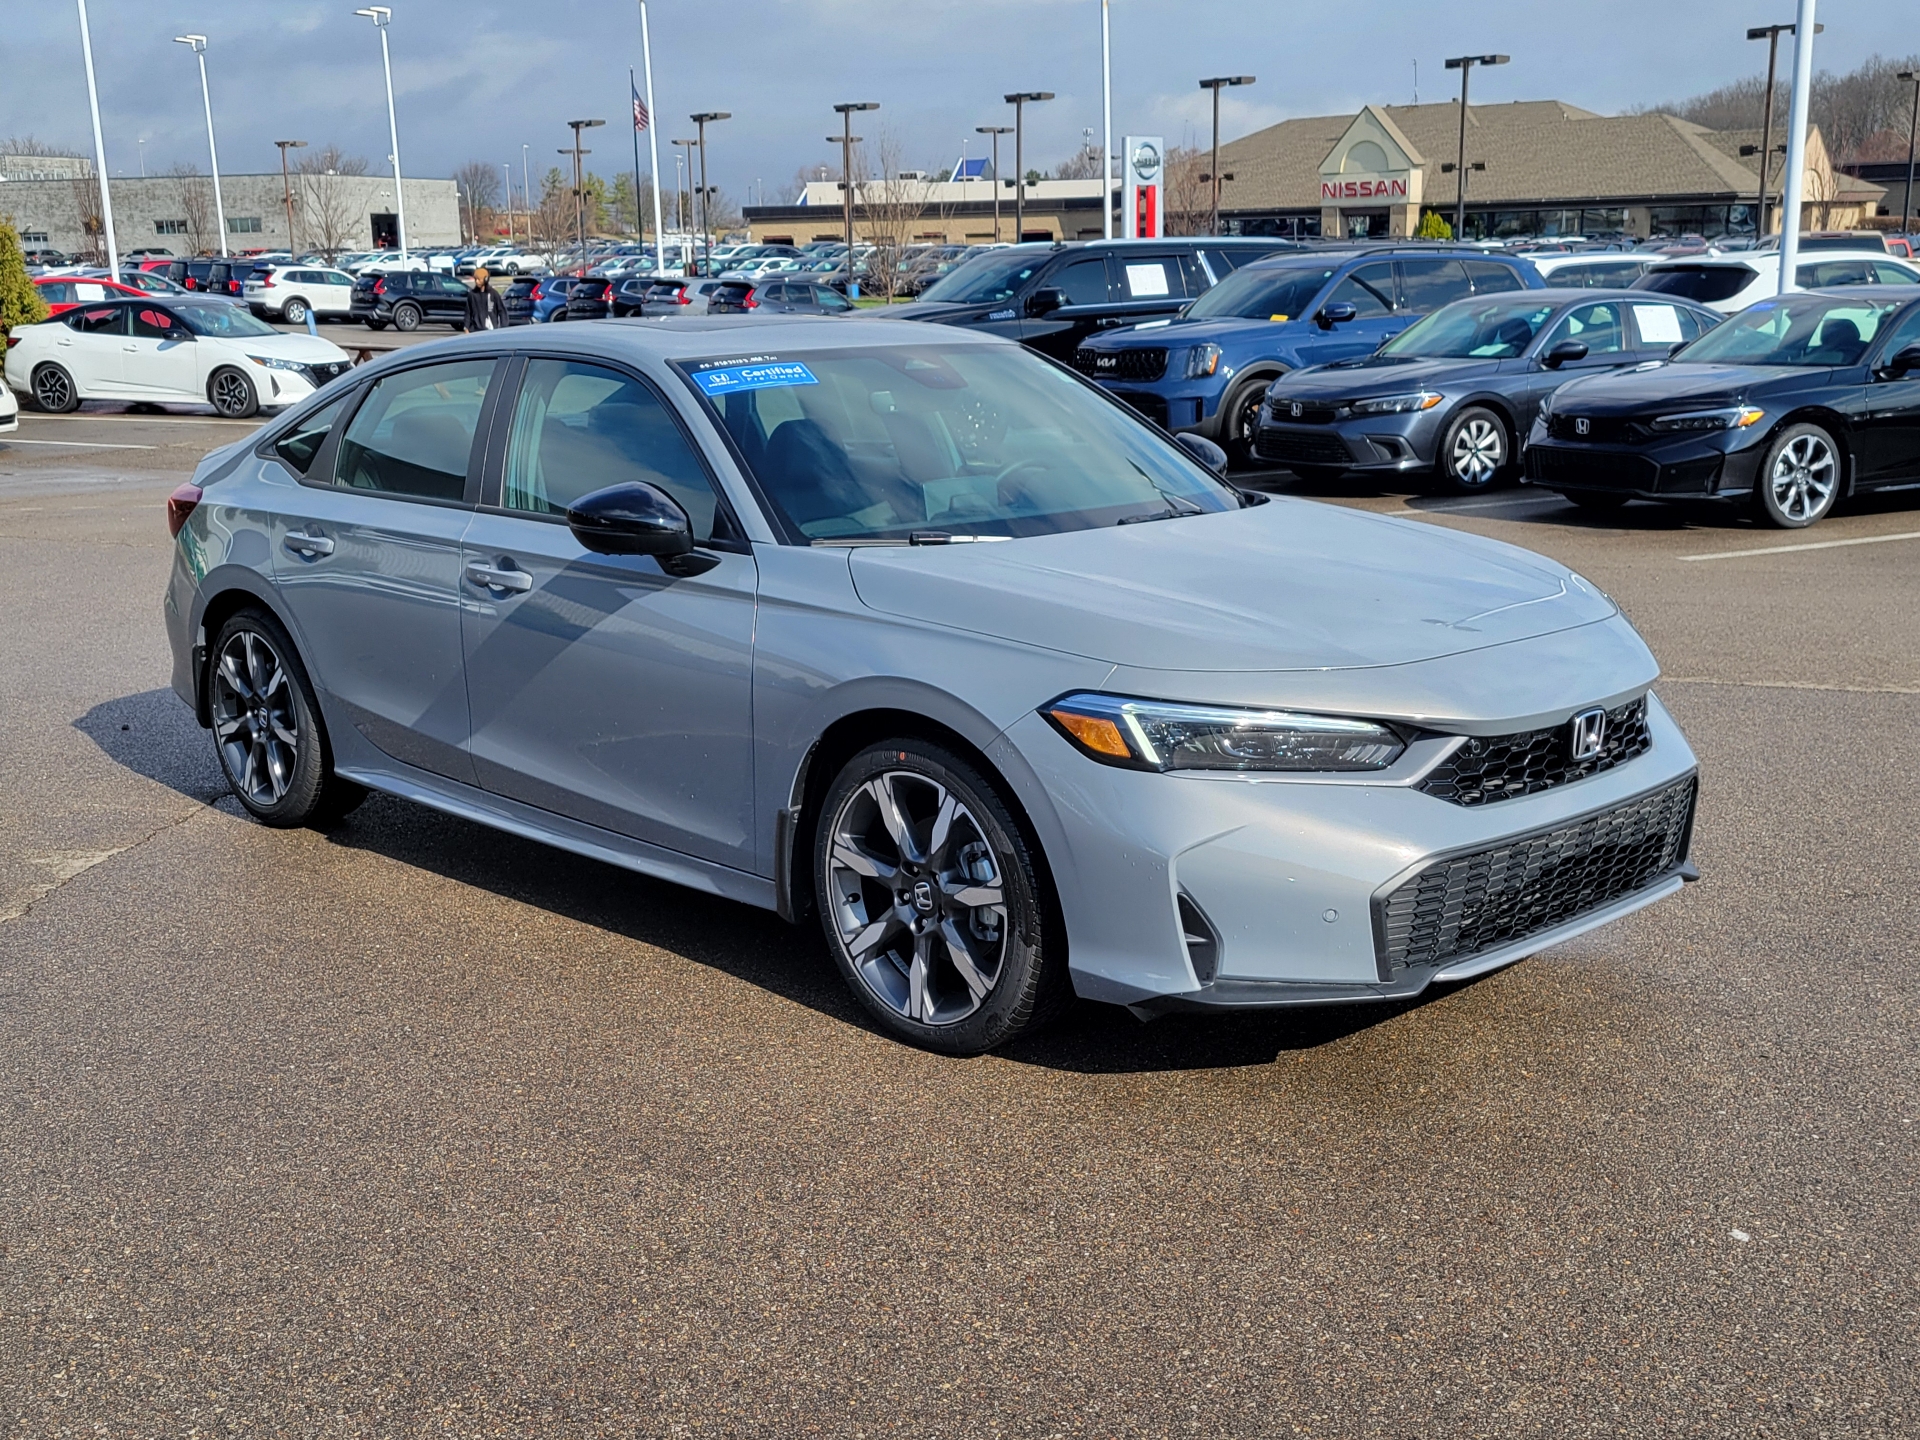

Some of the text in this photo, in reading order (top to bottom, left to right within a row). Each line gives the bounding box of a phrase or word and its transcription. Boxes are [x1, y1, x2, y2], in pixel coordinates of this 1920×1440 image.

[1321, 179, 1407, 199] NISSAN
[1096, 357, 1117, 367] KIA
[741, 365, 803, 378] Certified
